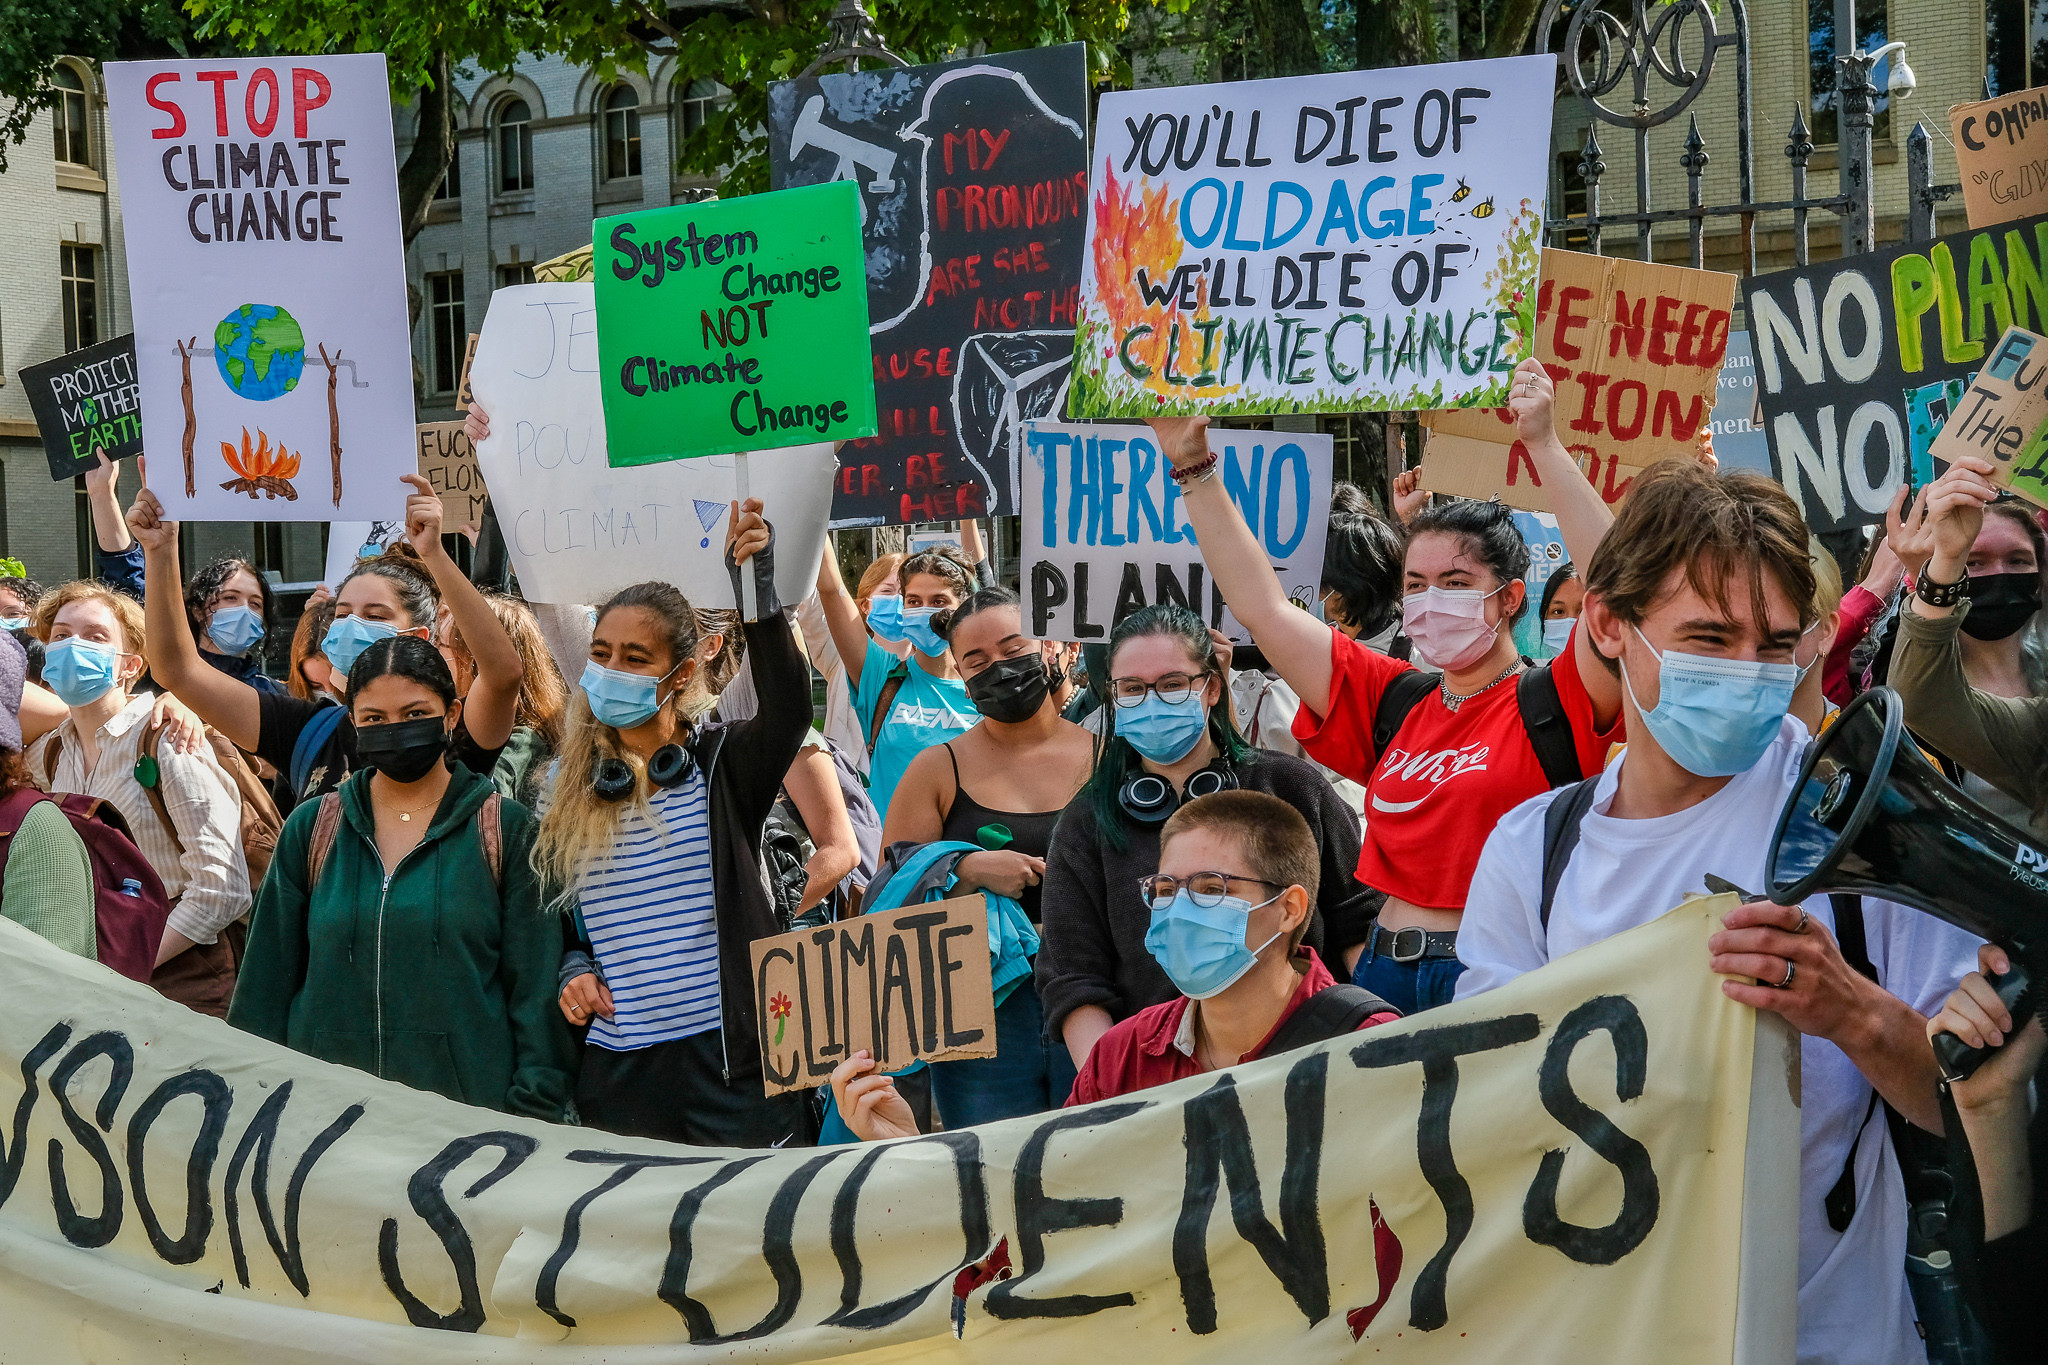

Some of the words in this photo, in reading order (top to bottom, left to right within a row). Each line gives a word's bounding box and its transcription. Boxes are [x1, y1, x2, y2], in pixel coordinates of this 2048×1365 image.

[145, 67, 332, 140] STOP
[1122, 104, 1271, 177] YOU'LL
[1294, 96, 1404, 167] DIE
[1415, 88, 1491, 156] OF
[162, 139, 350, 192] CLIMATE
[943, 128, 1010, 175] MY
[187, 190, 344, 243] CHANGE
[936, 171, 1087, 232] PRONOUNS
[1180, 176, 1313, 252] OLD
[1316, 173, 1445, 246] AGE
[611, 222, 759, 288] System
[722, 264, 841, 301] Change
[926, 254, 981, 307] ARE
[993, 242, 1050, 275] SHE
[1137, 256, 1256, 310] WE'LL
[1272, 251, 1370, 310] DIE
[1392, 243, 1471, 306] OF
[701, 299, 775, 349] NOT
[974, 290, 1043, 330] NOT
[1609, 289, 1730, 369] NEED
[1750, 269, 1883, 395] NO
[50, 352, 134, 405] PROTECT
[620, 352, 763, 397] Climate
[1120, 314, 1322, 388] CLIMATE
[1325, 308, 1520, 384] CHANGE
[730, 390, 849, 436] Change
[517, 420, 607, 477] POU
[906, 452, 948, 490] BE
[1774, 400, 1908, 524] NO
[900, 482, 988, 522] HER
[1027, 429, 1200, 549] THERE
[1223, 443, 1311, 559] NO
[757, 911, 985, 1087] CLIMATE
[377, 994, 1661, 1347] STUDENTS
